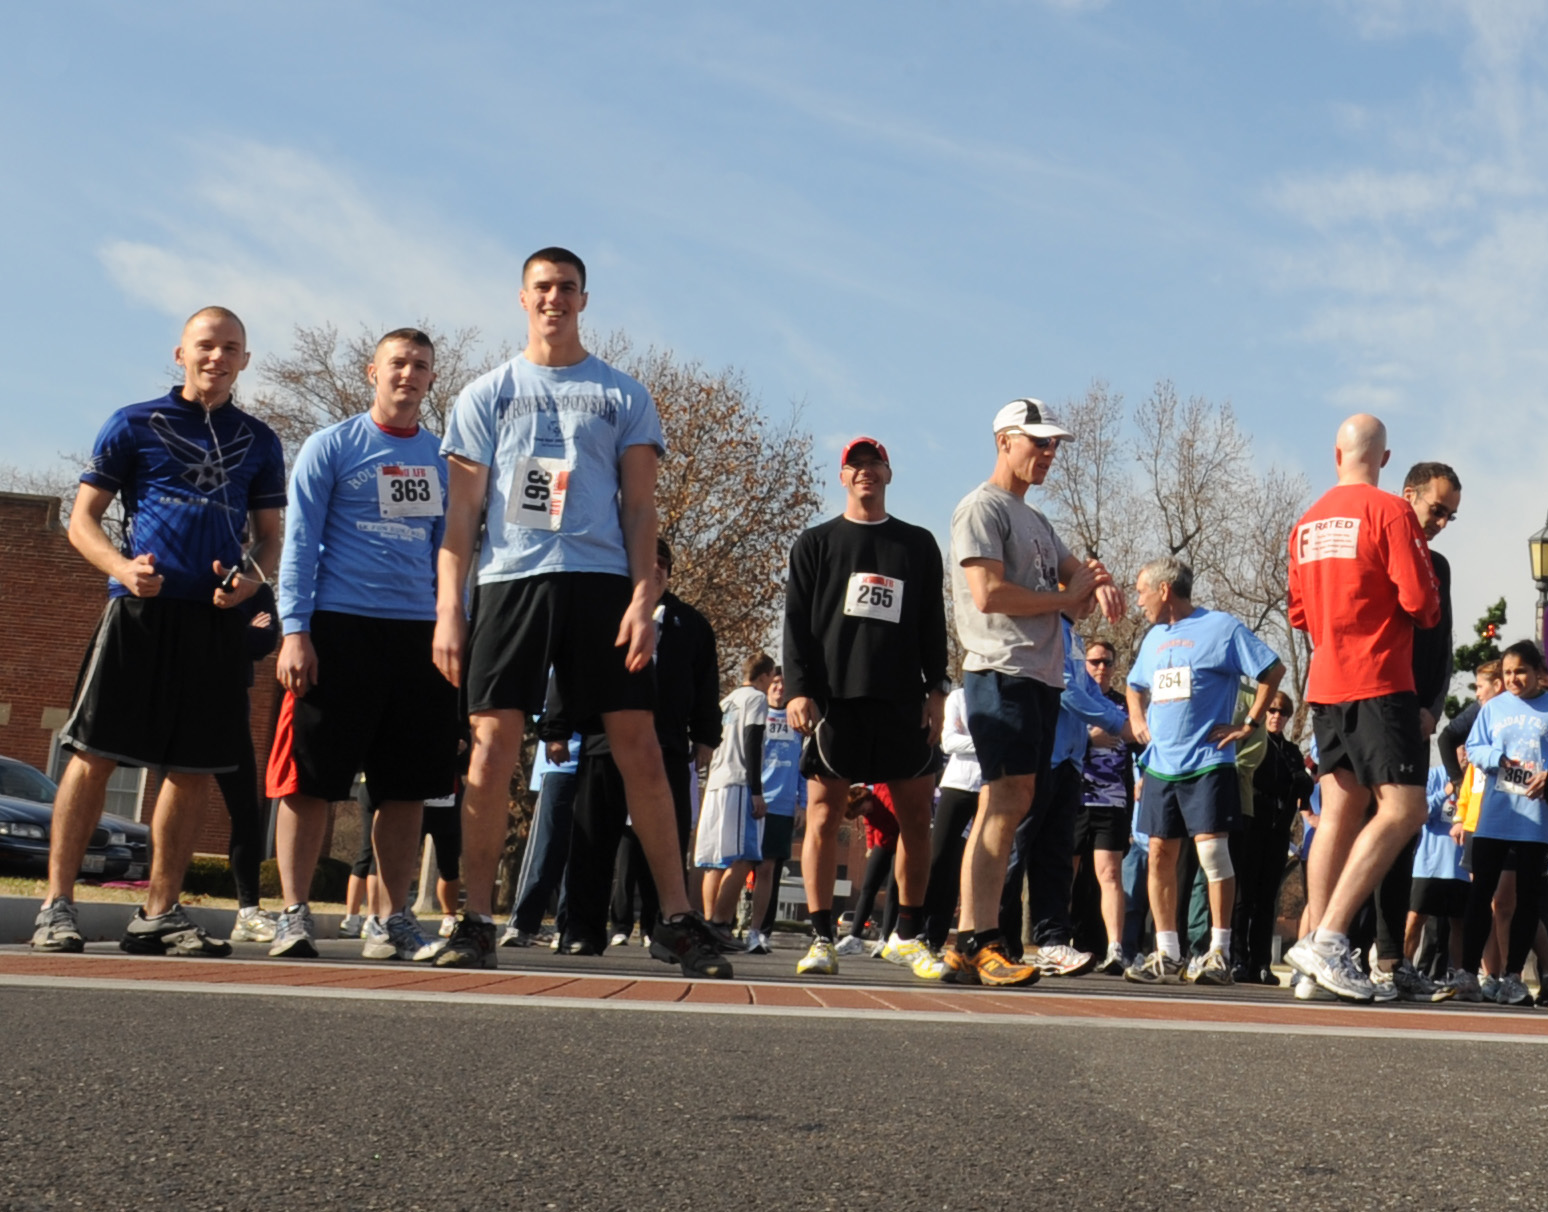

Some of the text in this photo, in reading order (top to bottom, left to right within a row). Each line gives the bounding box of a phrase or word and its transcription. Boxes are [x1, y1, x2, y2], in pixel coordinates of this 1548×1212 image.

[390, 479, 431, 503] 363
[522, 470, 553, 512] 361
[1315, 520, 1354, 531] RATED
[1300, 528, 1310, 558] F
[857, 584, 893, 608] 255
[1158, 671, 1182, 690] 254
[769, 722, 789, 734] 374
